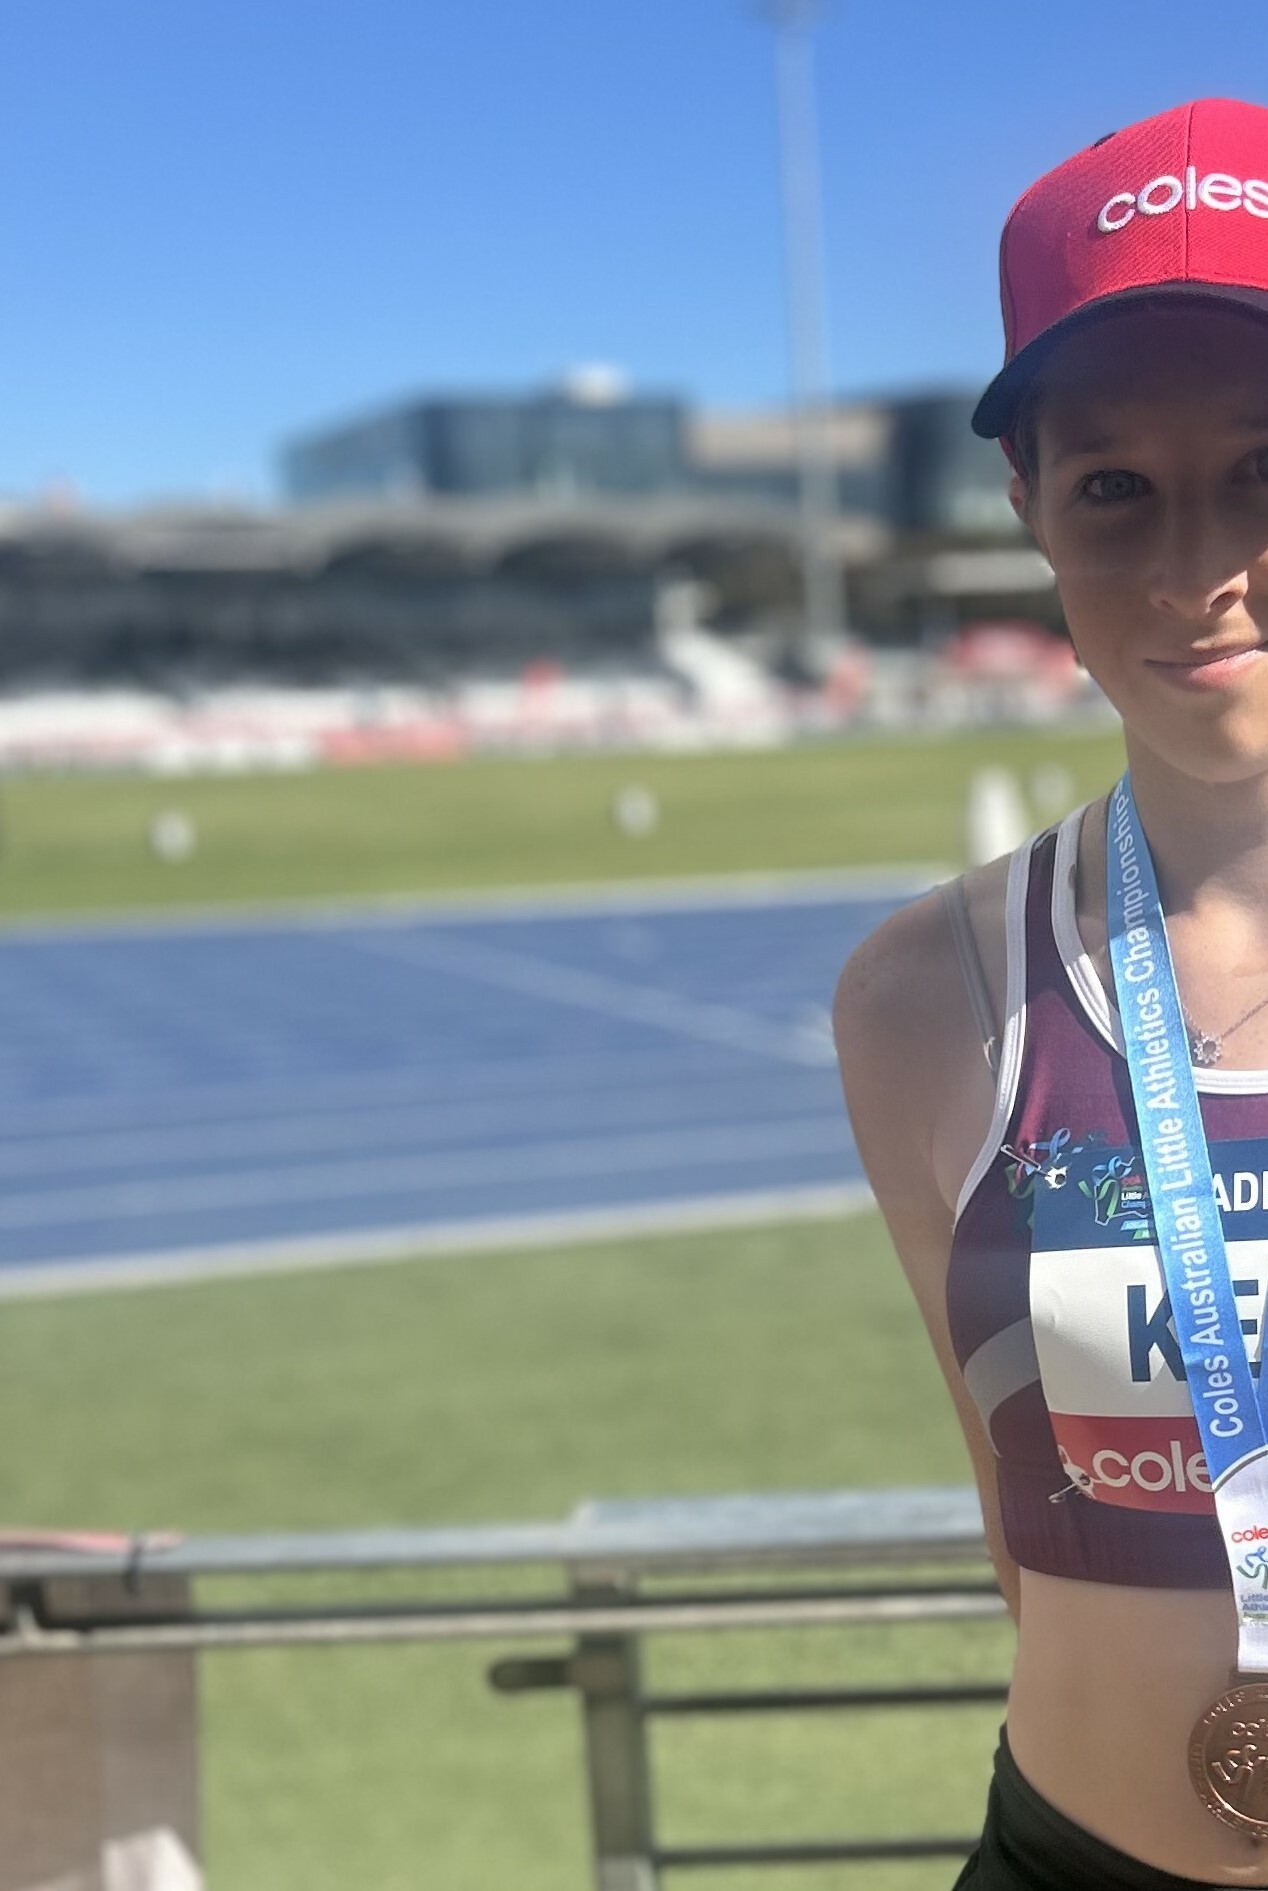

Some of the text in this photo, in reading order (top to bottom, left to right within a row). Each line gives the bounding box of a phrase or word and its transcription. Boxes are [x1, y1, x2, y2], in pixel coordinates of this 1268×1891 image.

[1134, 987, 1180, 1110] Athletics
[1153, 1117, 1193, 1192] Little
[1170, 1196, 1225, 1346] Australian
[1202, 1354, 1244, 1438] Coles
[1092, 1440, 1215, 1493] cole
